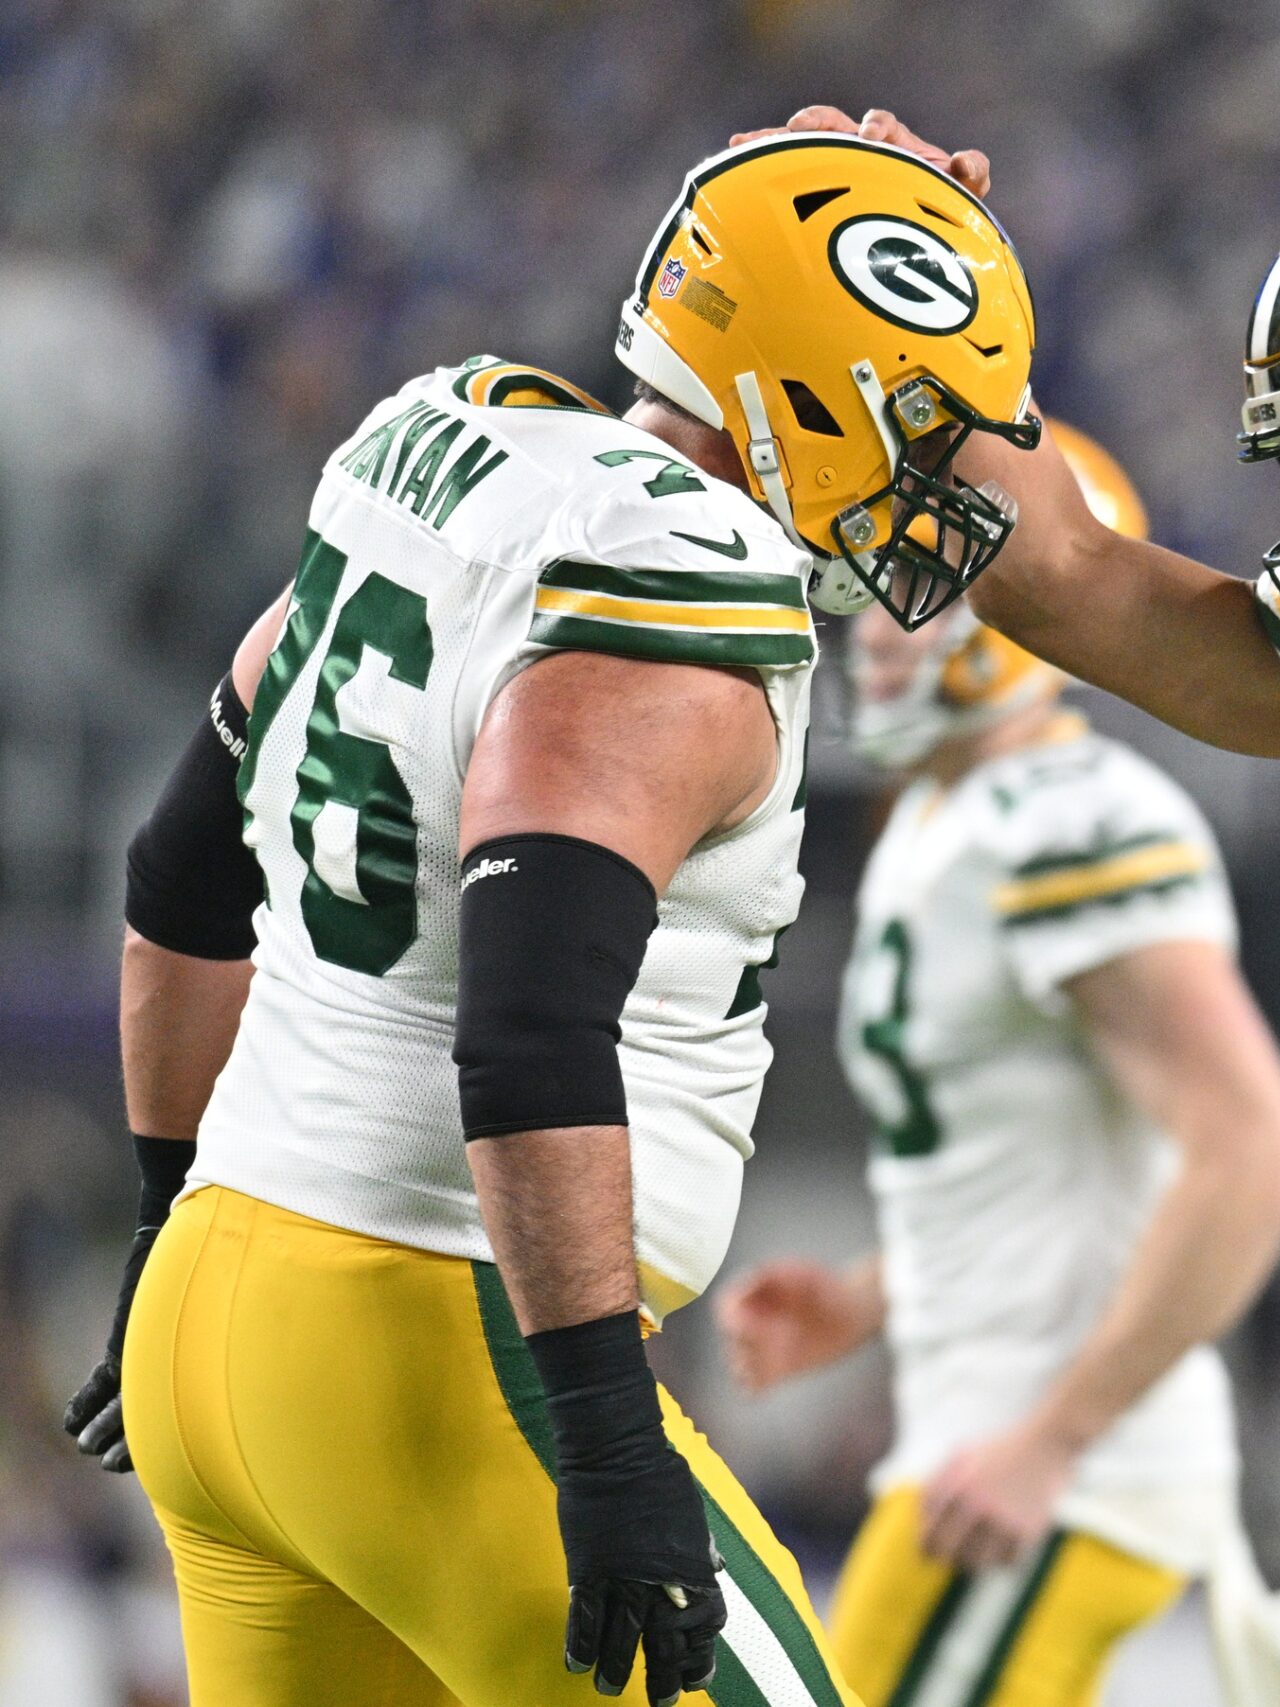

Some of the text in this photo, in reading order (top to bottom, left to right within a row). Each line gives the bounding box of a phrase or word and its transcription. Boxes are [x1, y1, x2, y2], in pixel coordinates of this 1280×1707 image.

[836, 220, 972, 329] G
[210, 679, 246, 762] Muell
[236, 524, 434, 977] 76
